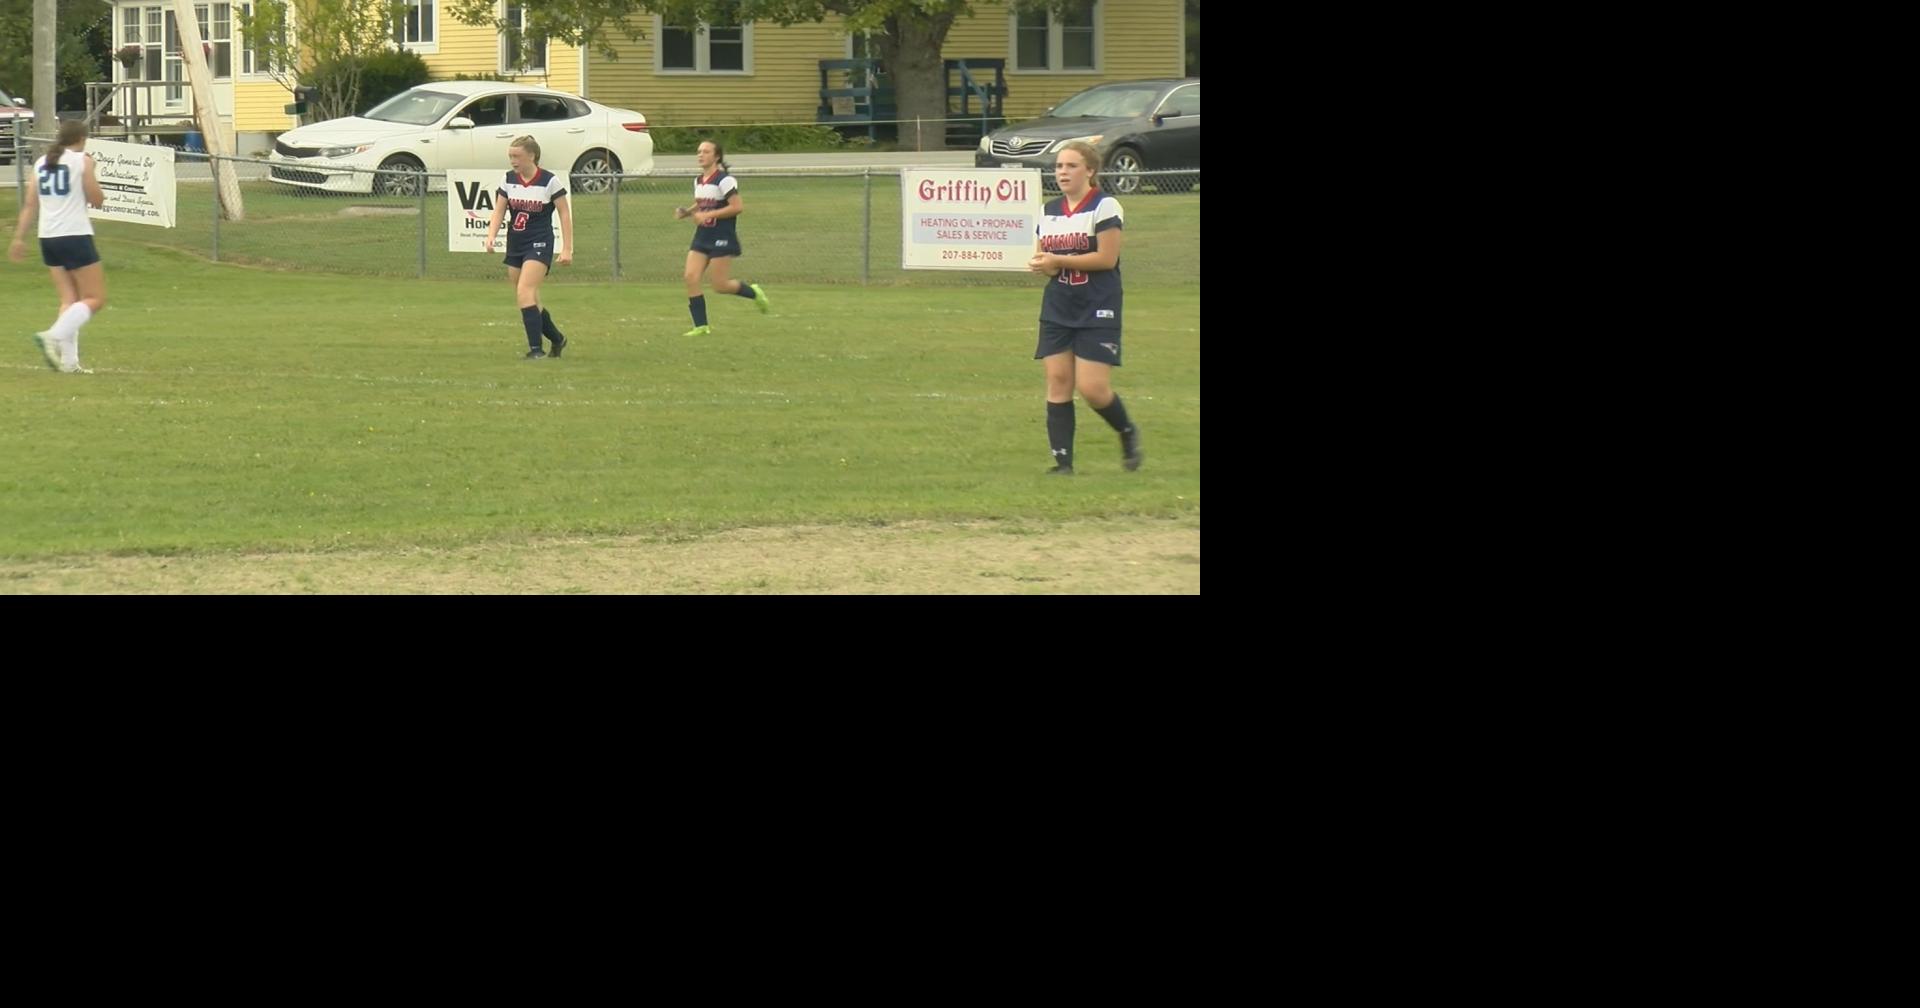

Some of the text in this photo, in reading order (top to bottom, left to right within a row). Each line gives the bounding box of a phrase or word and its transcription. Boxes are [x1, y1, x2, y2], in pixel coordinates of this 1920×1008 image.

[39, 164, 70, 196] 20
[455, 181, 500, 210] VA
[919, 179, 1026, 206] Griffin Oil
[465, 218, 490, 229] HOM
[920, 218, 1024, 229] HEATING OIL PROPANE
[936, 230, 1007, 241] SALES & SERVICE
[942, 249, 1003, 261] 207-884-7008
